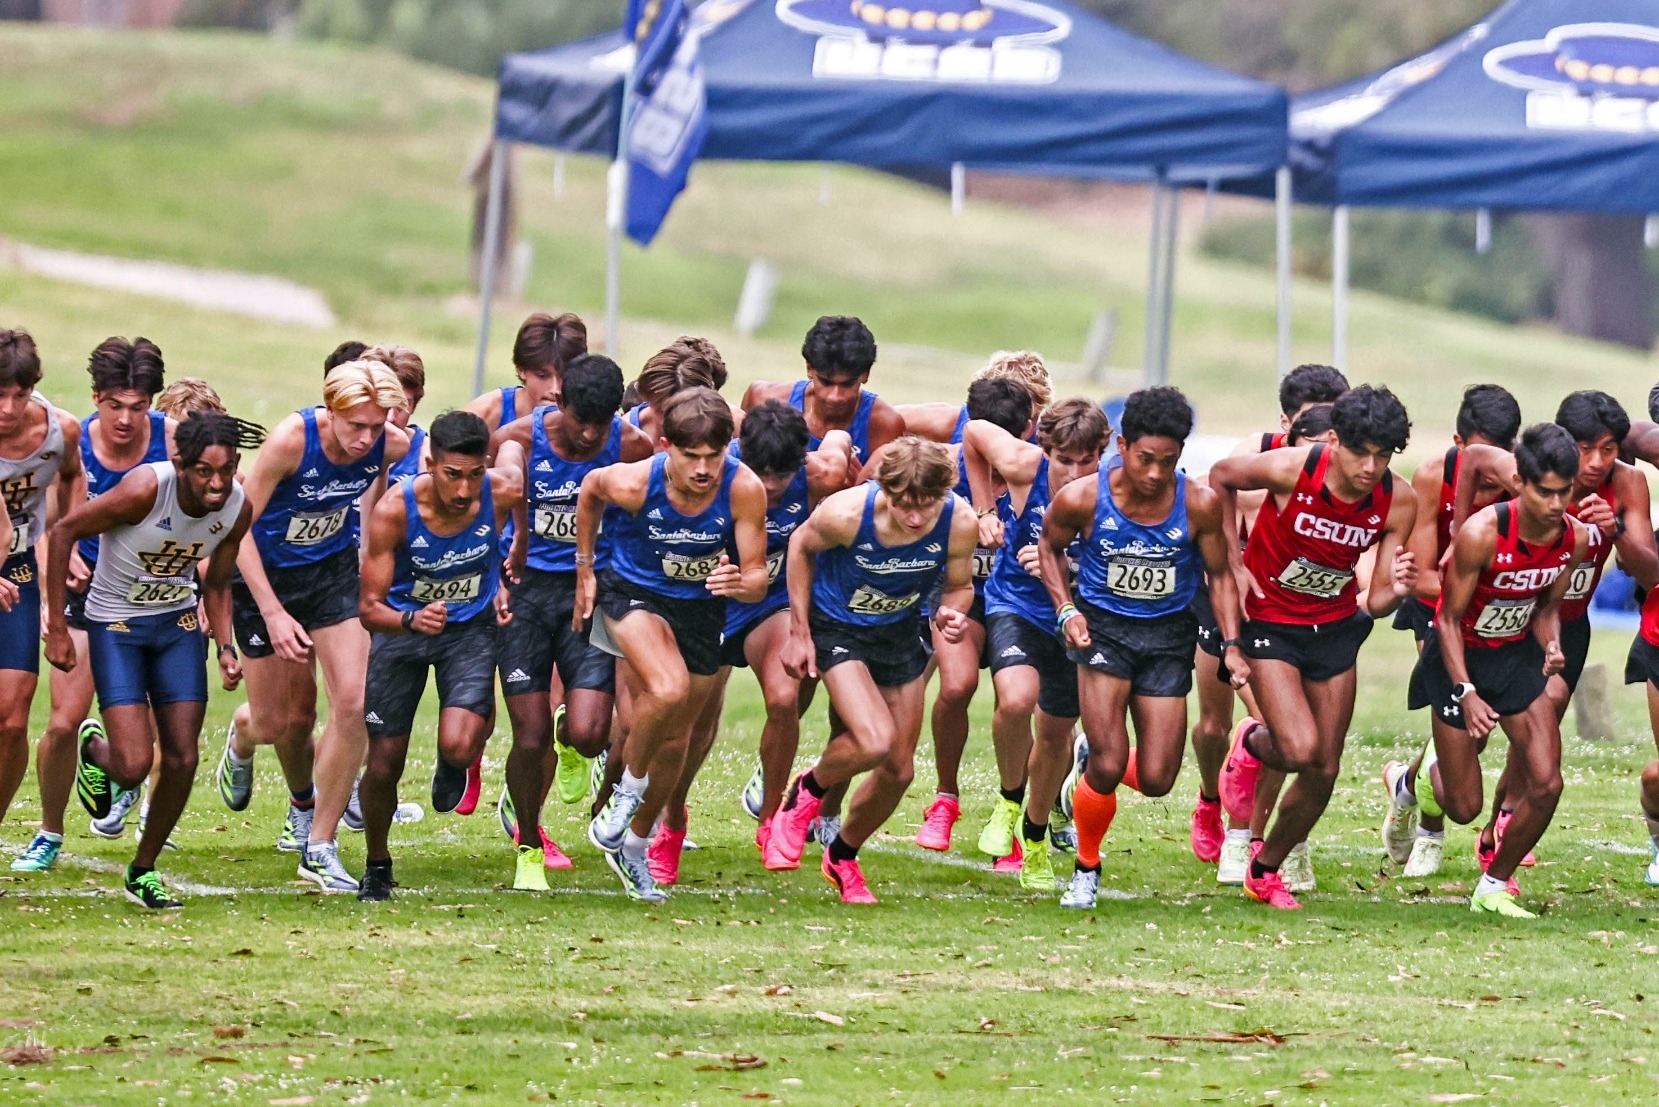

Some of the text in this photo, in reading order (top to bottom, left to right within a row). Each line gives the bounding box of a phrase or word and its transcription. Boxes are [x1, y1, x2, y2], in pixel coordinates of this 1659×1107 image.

[294, 511, 343, 540] 2678
[543, 511, 577, 538] 268
[1294, 511, 1378, 547] CSUN
[419, 579, 472, 600] 2694
[1114, 565, 1166, 593] 2693
[1286, 566, 1344, 591] 2555
